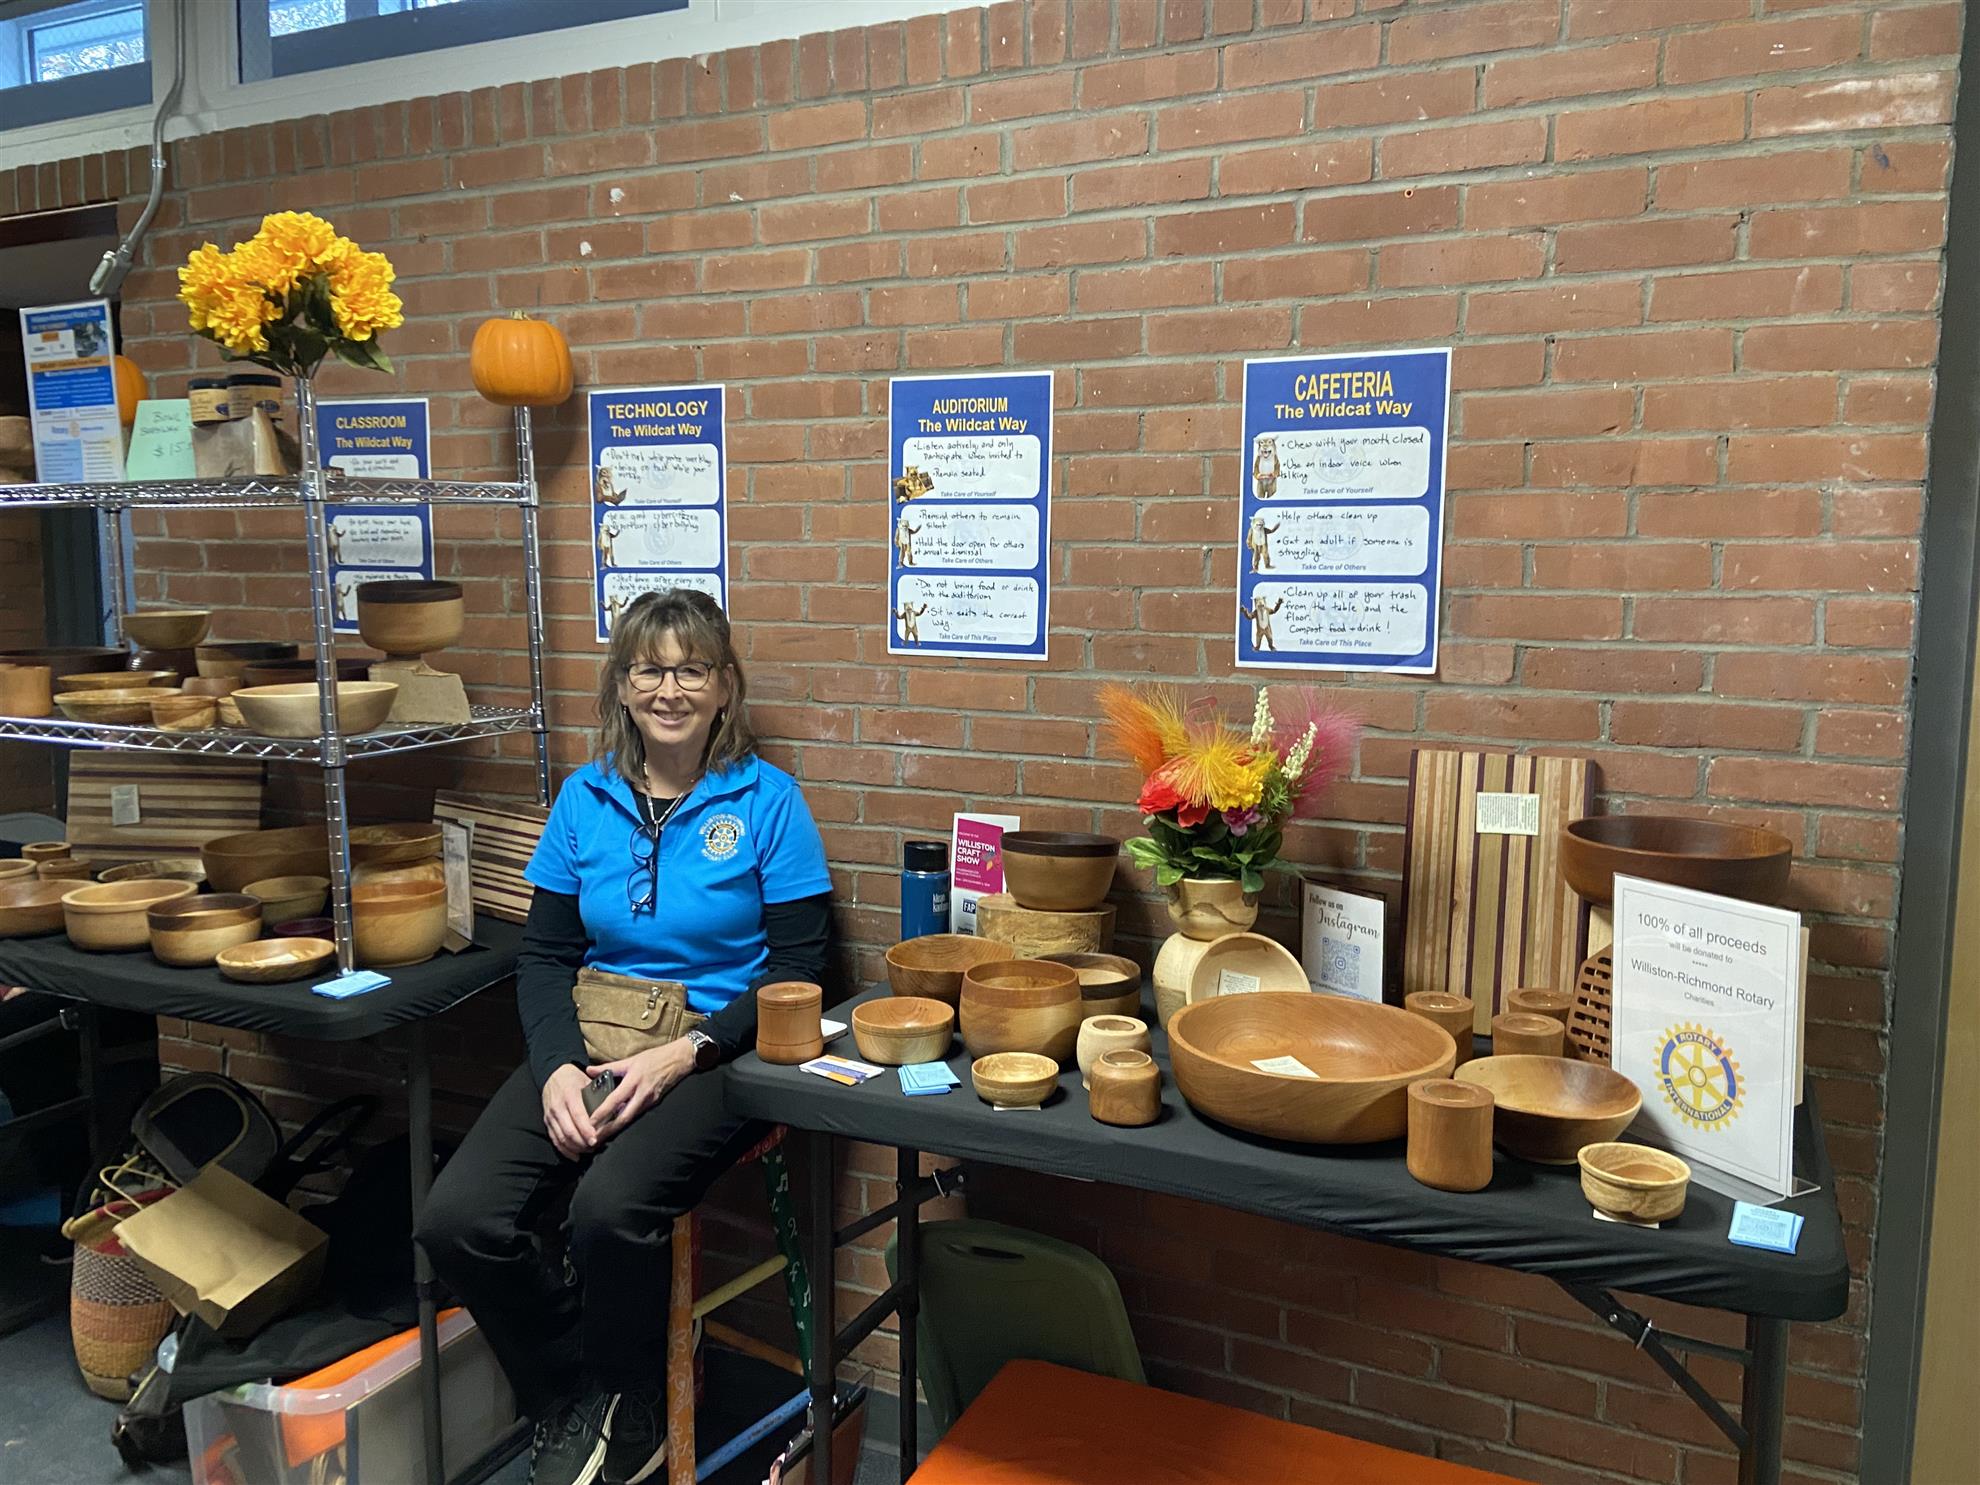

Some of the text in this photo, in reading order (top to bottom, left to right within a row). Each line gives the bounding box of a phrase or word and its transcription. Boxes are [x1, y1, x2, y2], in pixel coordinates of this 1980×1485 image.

[1294, 371, 1393, 401] CAFETERIA
[606, 401, 708, 419] TECHNOLOGY
[933, 397, 1008, 414] AUDITORIUM
[1274, 401, 1412, 419] The Wildcat Way
[336, 416, 406, 429] CLASSROOM
[918, 417, 1027, 433] The Wildcat Way
[611, 423, 702, 437] The Wildcat Way
[336, 436, 412, 449] The Wildcat Way
[917, 440, 943, 450] Listen
[981, 438, 994, 448] and
[998, 438, 1013, 450] only
[1287, 433, 1424, 454] Chew with your mouth closed
[1016, 450, 1022, 459] to
[1286, 460, 1301, 469] Use
[1319, 459, 1343, 467] indoor
[1281, 471, 1308, 484] talking
[921, 509, 948, 519] Remind
[952, 511, 975, 519] others
[980, 512, 987, 520] to
[1281, 511, 1301, 522] Help
[1368, 513, 1378, 523] up
[919, 538, 933, 547] Hold
[936, 538, 948, 547] the
[952, 536, 966, 547] door
[990, 537, 999, 547] for
[1283, 537, 1299, 545] Get
[1320, 536, 1344, 544] adult
[1349, 537, 1356, 545] if
[1363, 538, 1400, 546] someone
[1404, 538, 1413, 546] is
[918, 579, 930, 588] Do
[954, 581, 973, 593] bring
[979, 581, 995, 590] food
[1014, 583, 1033, 592] drink
[1286, 587, 1313, 597] Clean
[1317, 592, 1328, 601] up
[1333, 590, 1343, 598] all
[1364, 592, 1384, 604] your
[1390, 590, 1416, 600] trash
[931, 607, 942, 616] Sit
[983, 610, 993, 618] the
[1284, 602, 1408, 614] from the table and the
[1289, 623, 1322, 634] Compost
[1329, 624, 1346, 633] food
[1357, 623, 1381, 632] drink
[1300, 638, 1313, 646] Take
[958, 839, 995, 853] WILLISTON
[958, 848, 981, 858] CRAFT
[957, 855, 980, 865] SHOW
[1328, 900, 1335, 908] us
[1317, 908, 1379, 940] Instagram
[1638, 913, 1767, 955] 100% of all proceeds
[1669, 942, 1733, 964] will be donated to
[1631, 958, 1774, 1010] Williston-Richmond Rotary
[1684, 992, 1715, 1007] Charities
[1680, 1032, 1717, 1051] ROTARY
[1665, 1083, 1732, 1120] INTERNATIONAL
